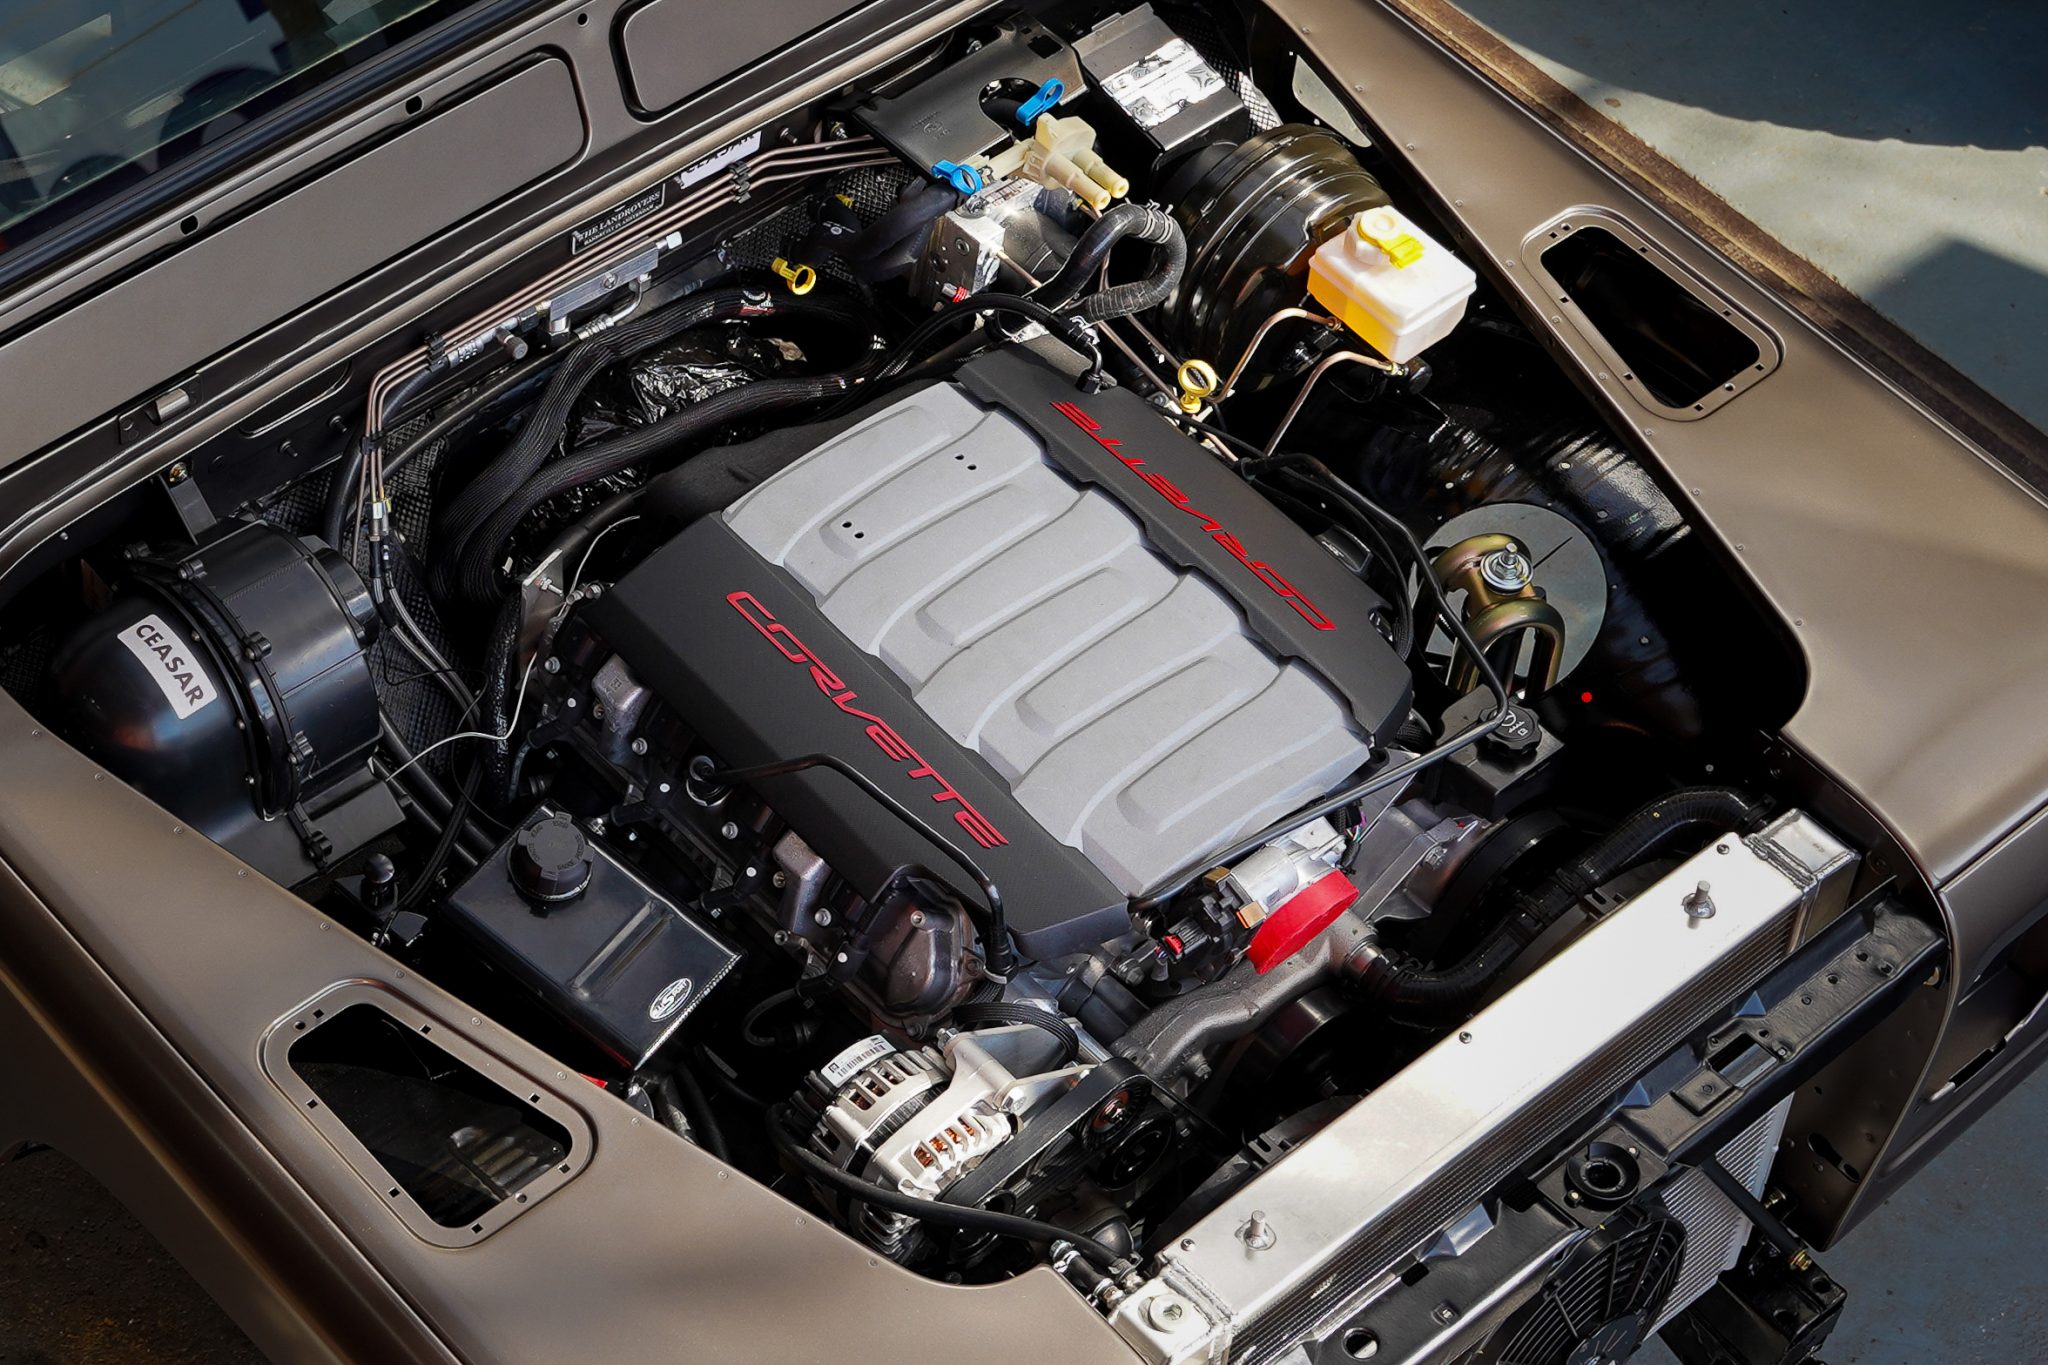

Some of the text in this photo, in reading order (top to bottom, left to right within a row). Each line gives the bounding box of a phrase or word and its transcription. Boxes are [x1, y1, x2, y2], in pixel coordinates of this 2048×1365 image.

[1050, 401, 1337, 631] CORVETTE
[136, 624, 204, 707] CEASAR
[726, 591, 1009, 849] CORVETTE
